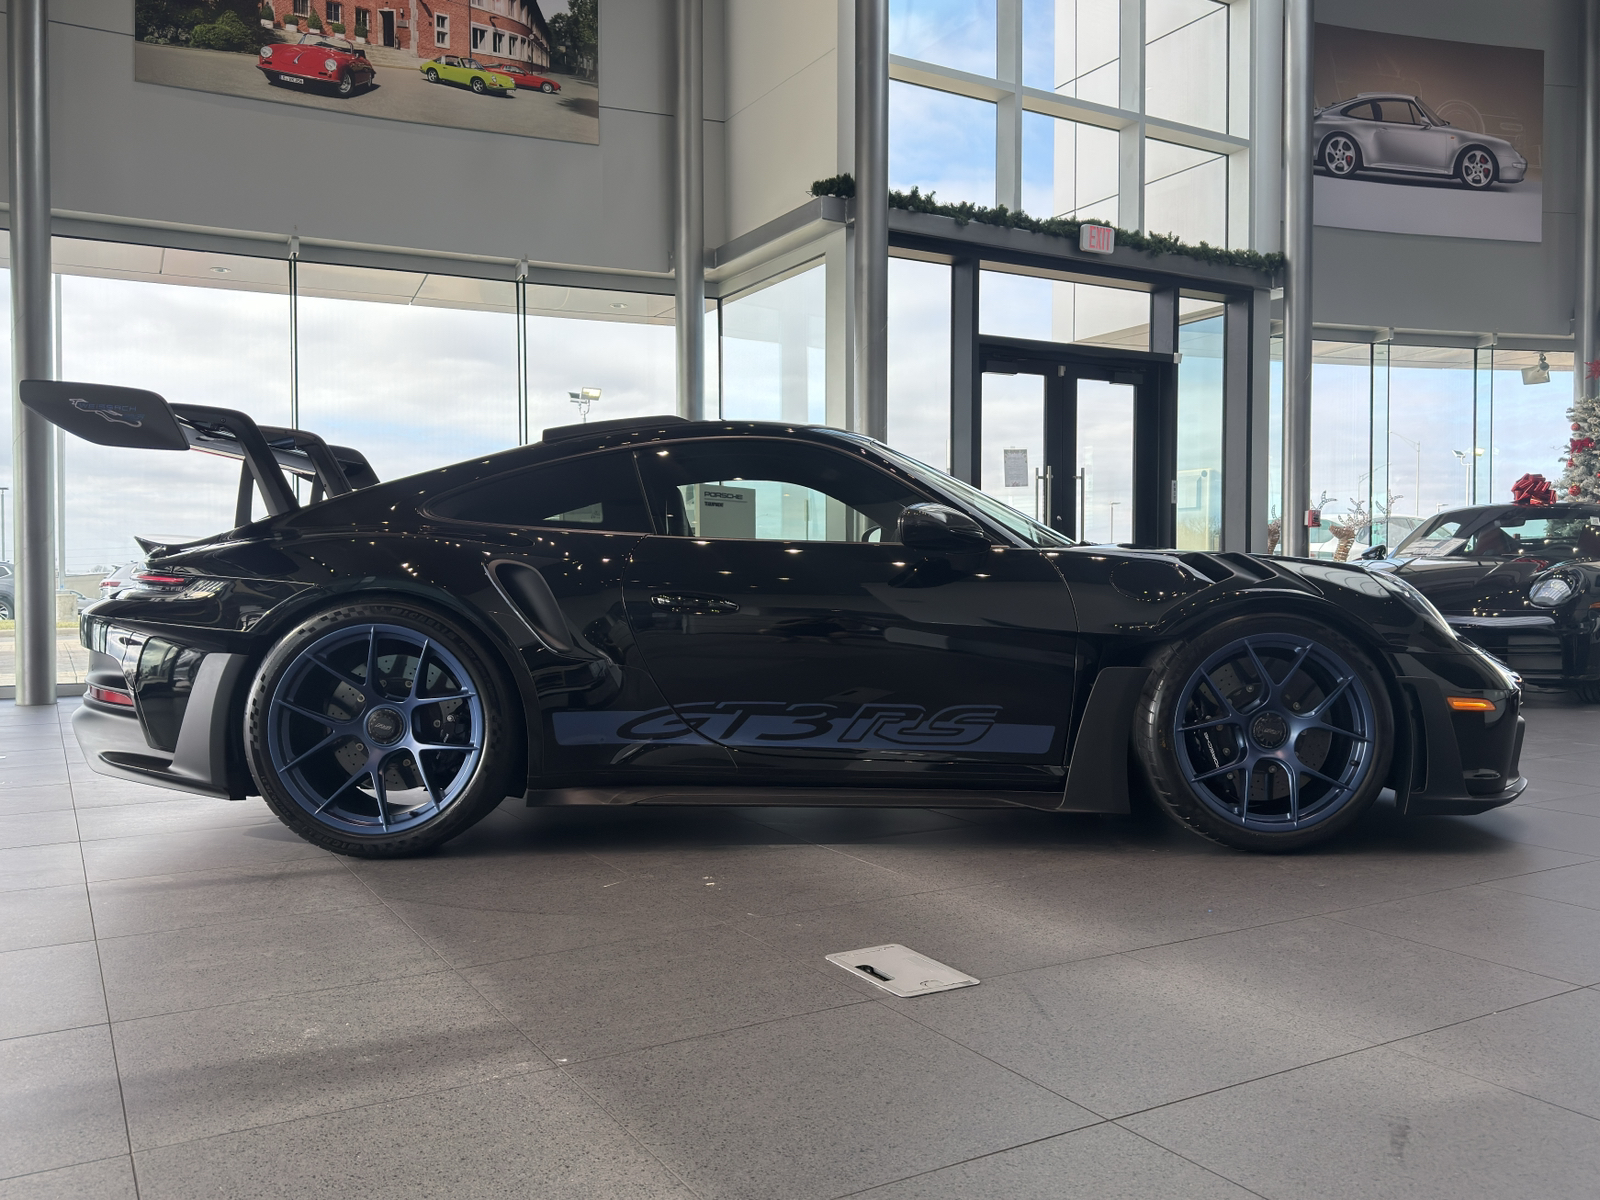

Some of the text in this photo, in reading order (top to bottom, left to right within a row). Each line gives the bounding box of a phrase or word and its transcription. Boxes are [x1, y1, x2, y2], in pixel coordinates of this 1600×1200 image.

[1088, 225, 1112, 252] EXIT
[78, 403, 137, 412] WEISSACH
[704, 491, 743, 500] PORSCHE
